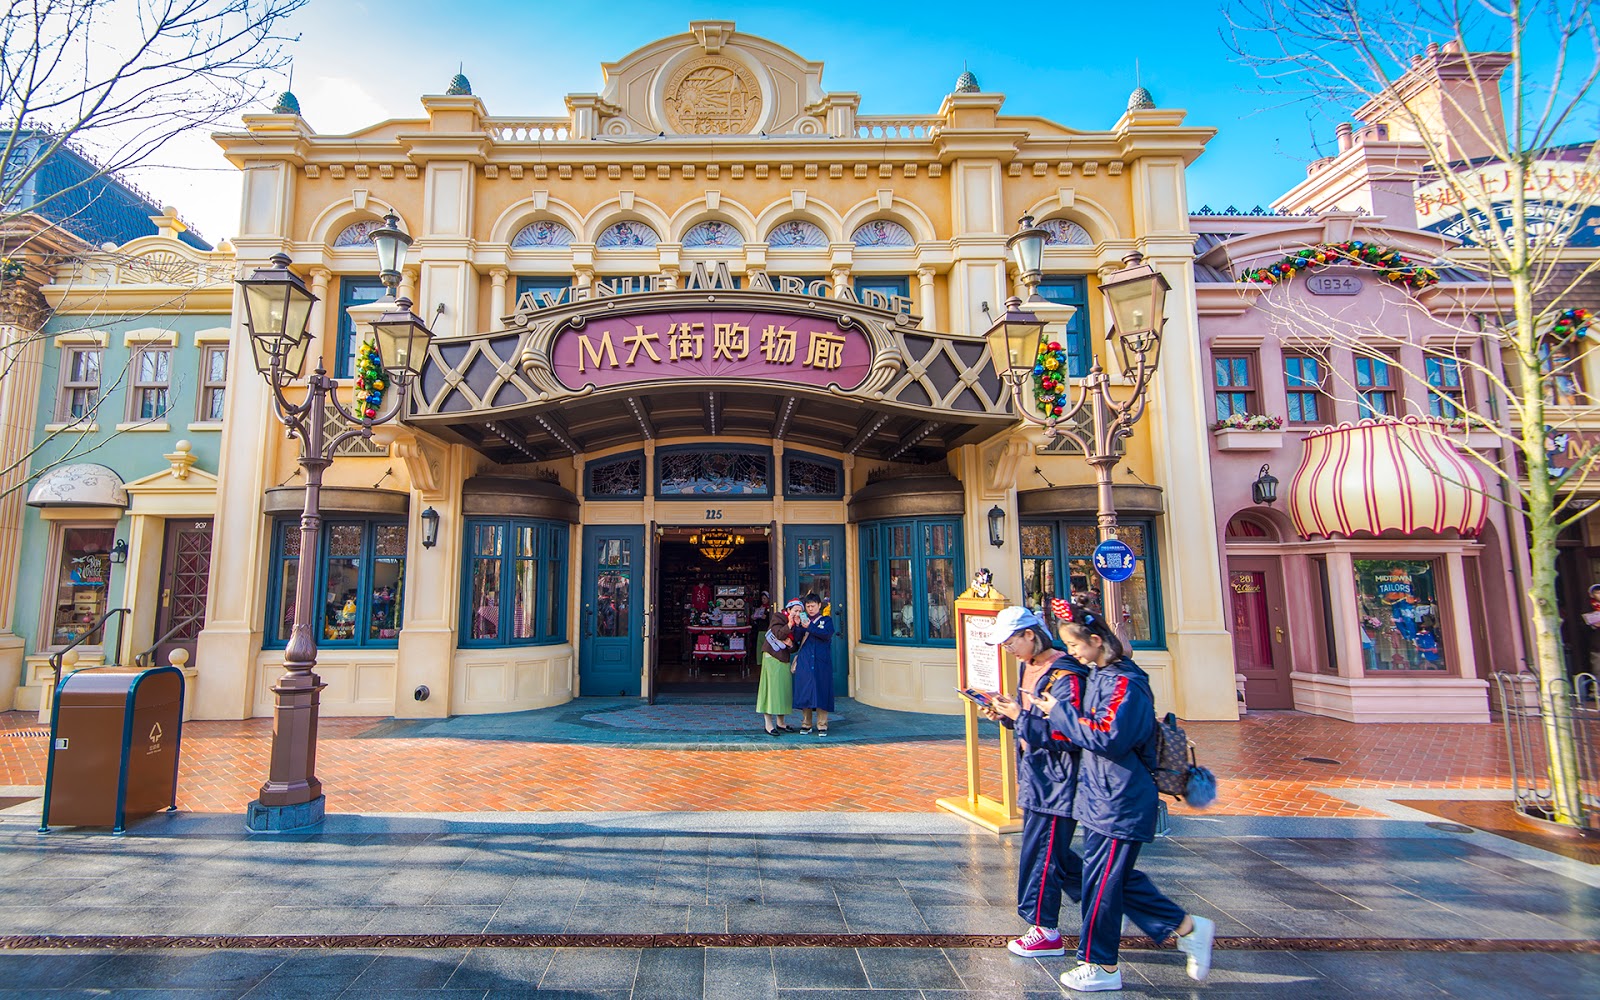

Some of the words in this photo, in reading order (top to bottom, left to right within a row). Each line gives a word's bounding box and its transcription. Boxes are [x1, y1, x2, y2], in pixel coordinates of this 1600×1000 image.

[1501, 206, 1573, 223] DSNEY
[513, 274, 673, 315] AVENUE
[687, 260, 735, 290] M
[749, 269, 914, 315] ARCADE
[1318, 279, 1352, 290] 1934
[578, 322, 846, 372] M大街购物廊
[705, 509, 723, 520] 225
[1379, 583, 1411, 593] TAILORS
